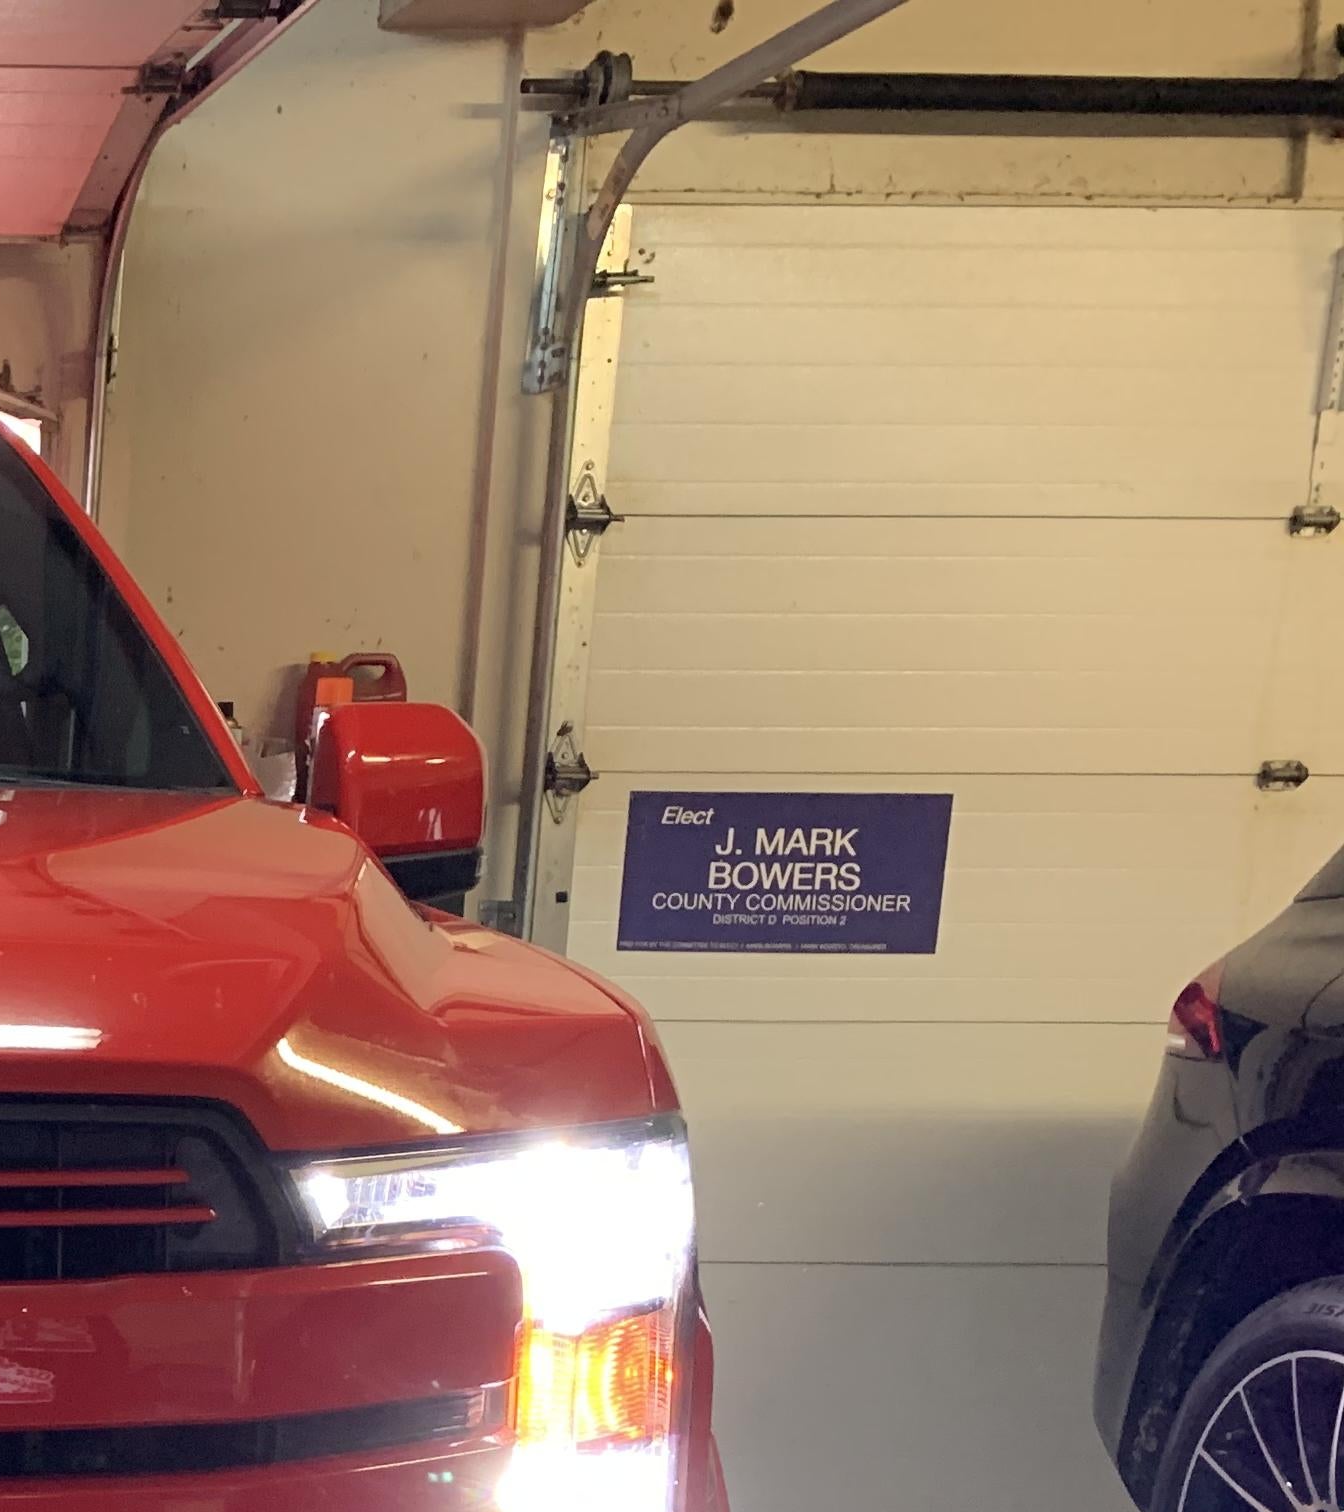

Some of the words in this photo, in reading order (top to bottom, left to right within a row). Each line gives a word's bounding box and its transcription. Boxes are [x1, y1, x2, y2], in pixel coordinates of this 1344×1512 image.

[661, 805, 715, 825] Elect
[715, 827, 742, 855] J.
[755, 827, 859, 856] MARK
[708, 861, 861, 891] BOWERS
[652, 892, 740, 910] COUNTY
[745, 893, 911, 912] COMMISSIONER
[712, 913, 766, 925] DISTRICT
[782, 914, 837, 925] POSITION
